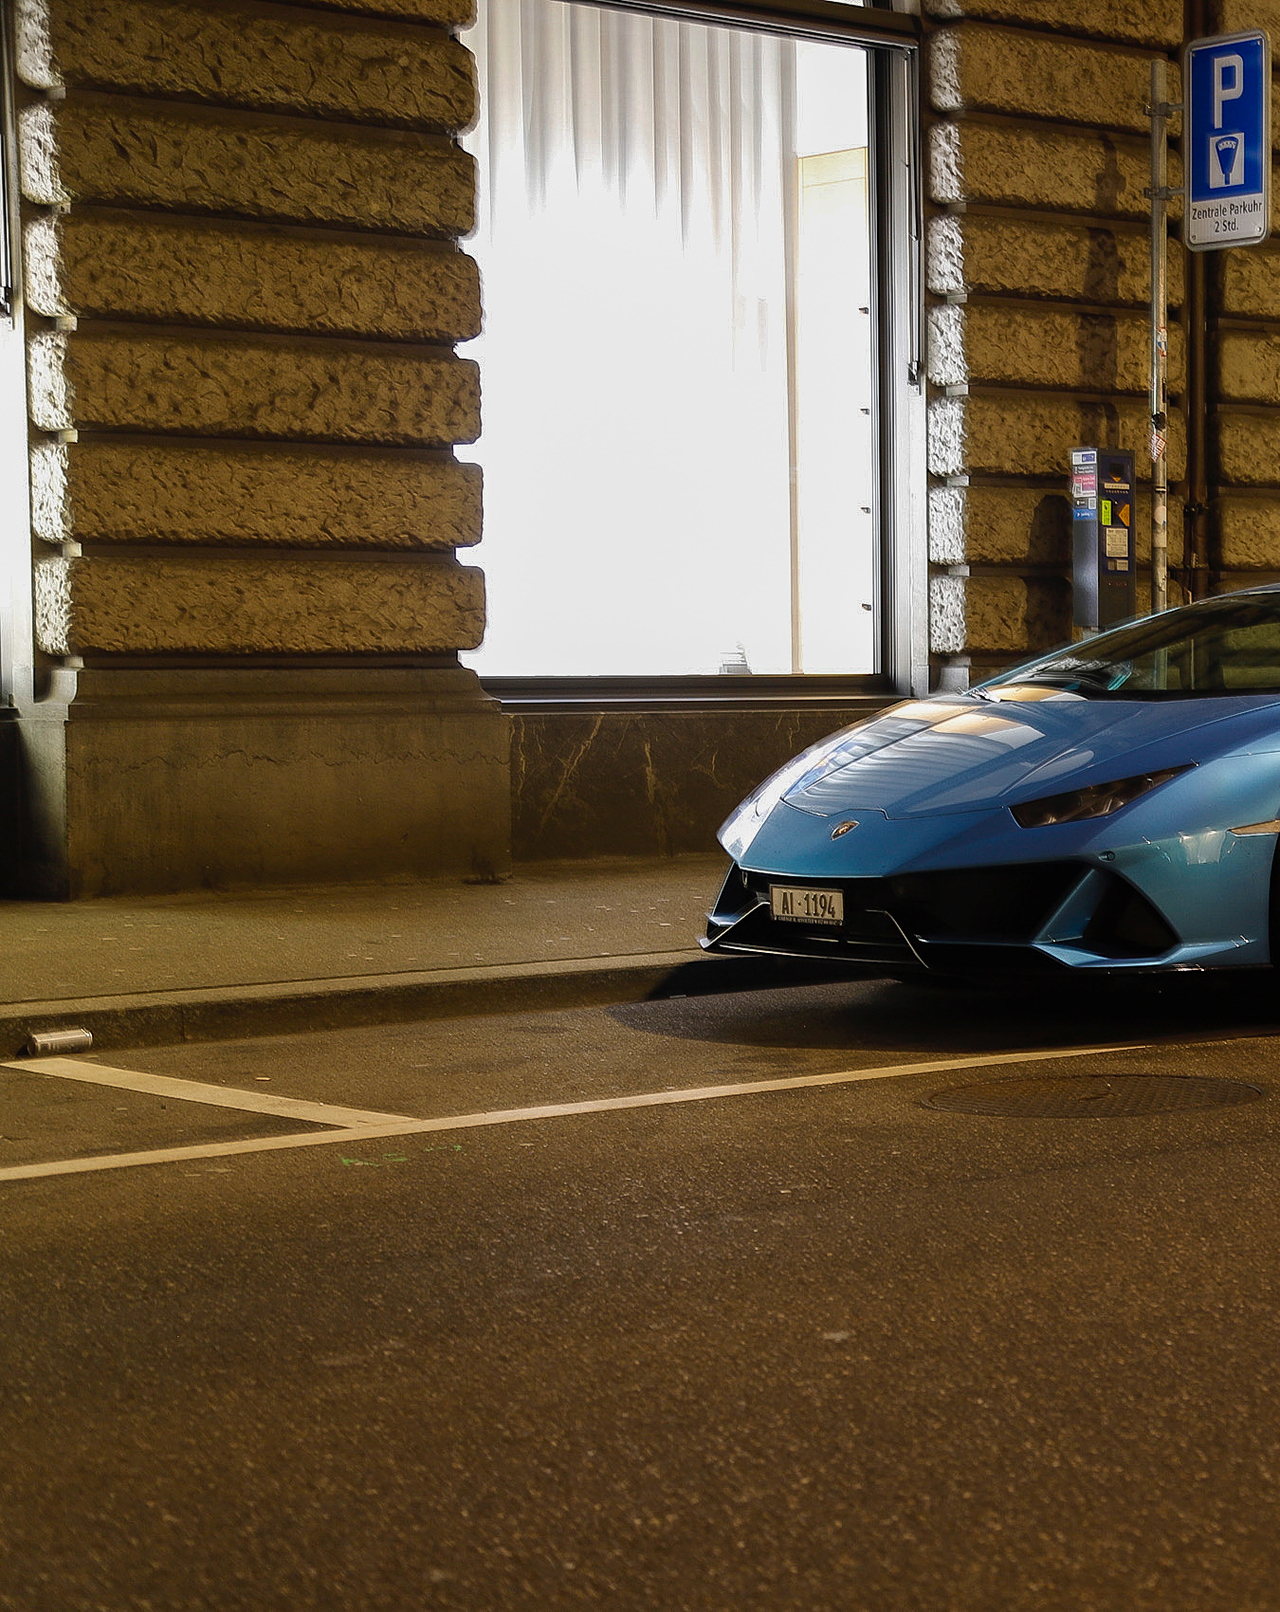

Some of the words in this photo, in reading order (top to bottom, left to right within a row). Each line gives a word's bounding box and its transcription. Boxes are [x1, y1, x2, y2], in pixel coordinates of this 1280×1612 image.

[1213, 53, 1244, 129] P
[1192, 203, 1227, 220] Zentrale
[1229, 200, 1262, 215] Parkuhr
[1215, 221, 1220, 233] 2
[1223, 218, 1239, 232] Std.
